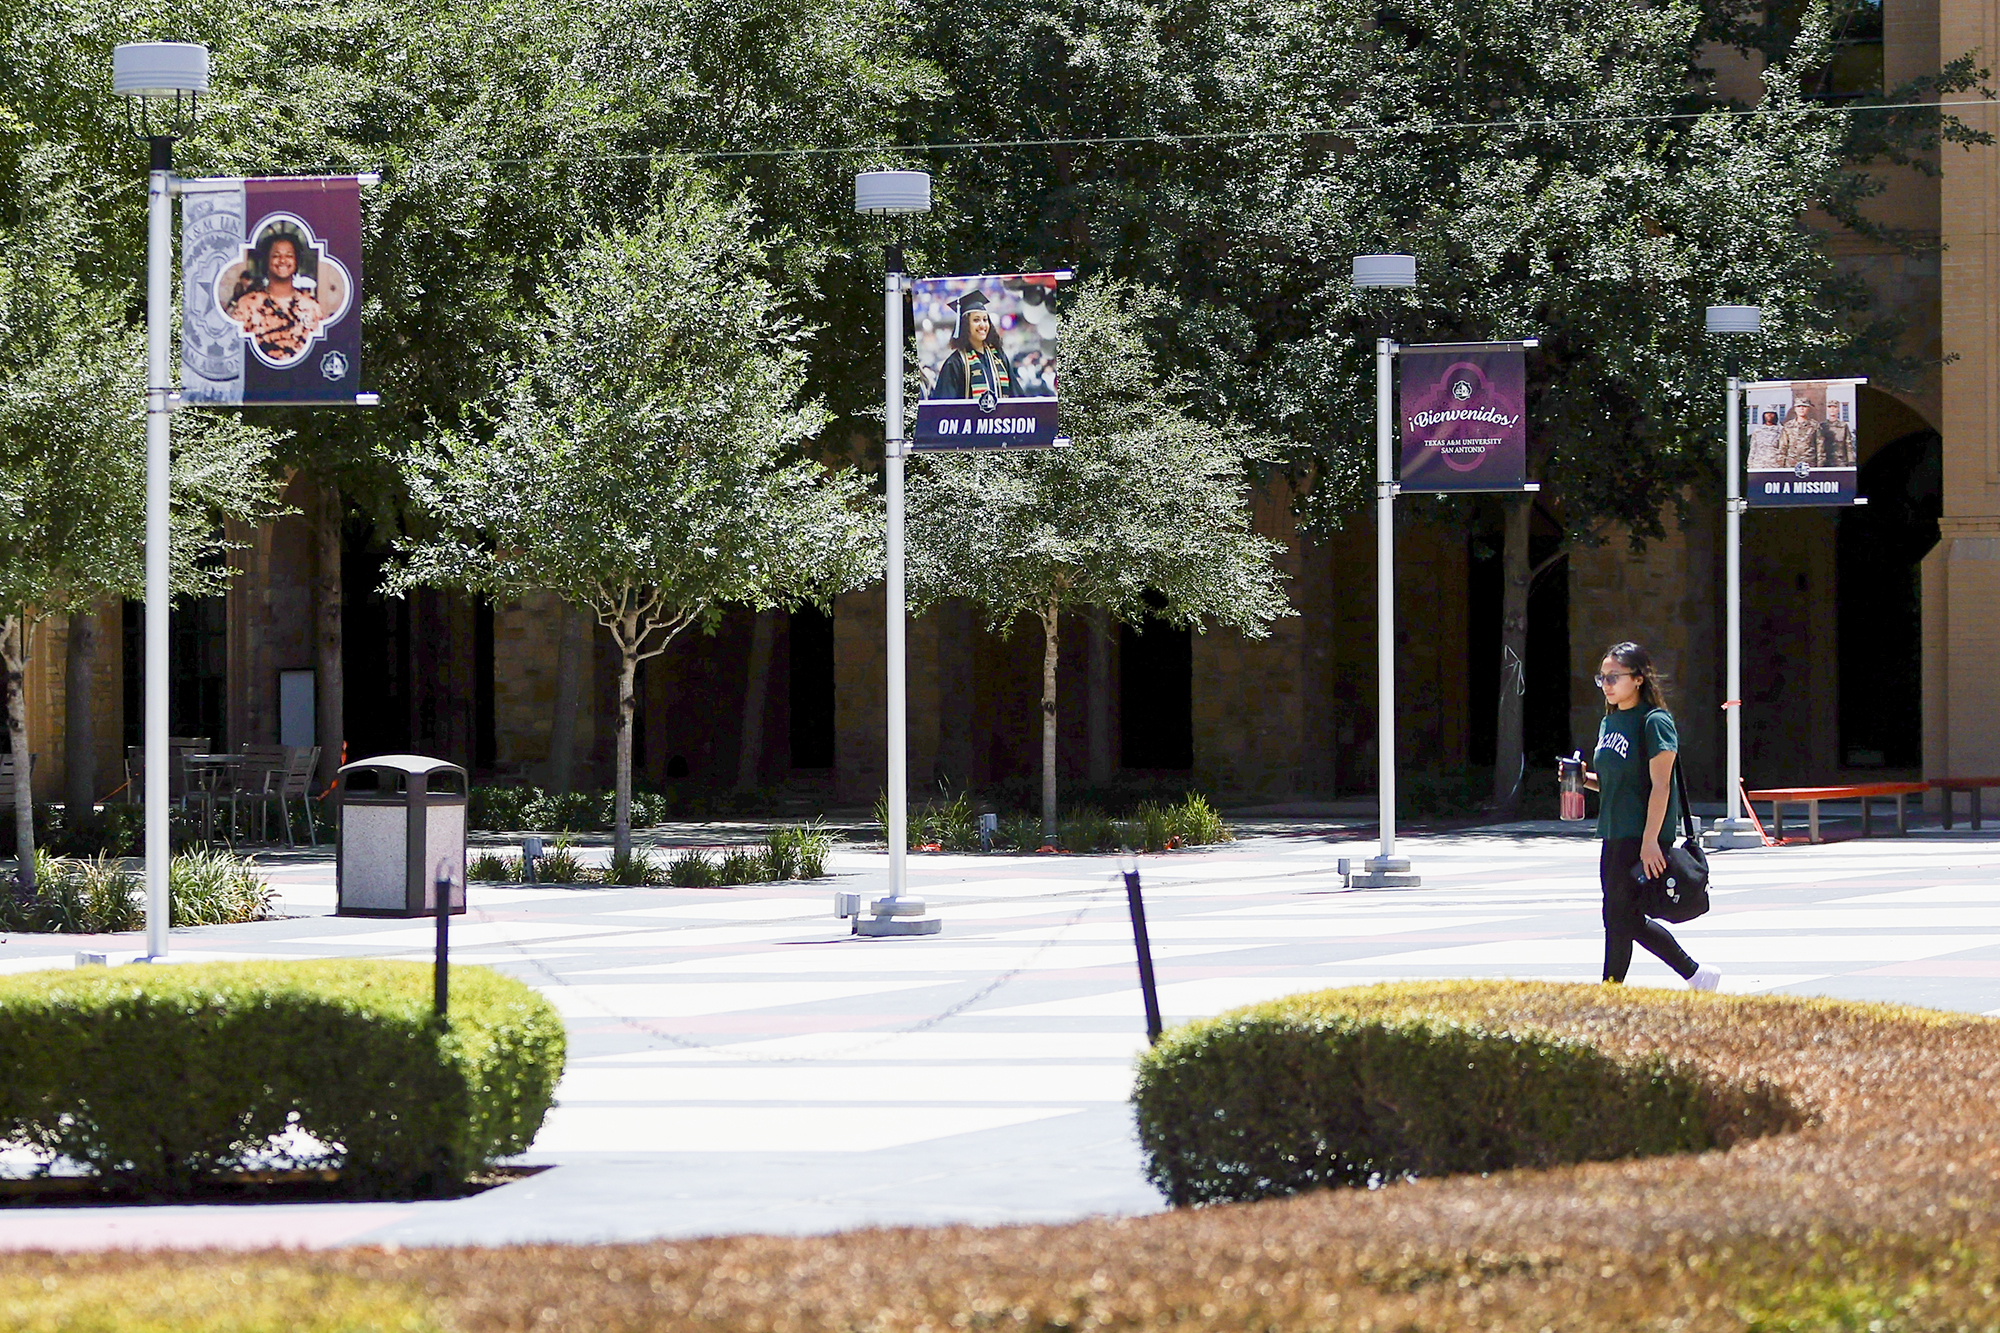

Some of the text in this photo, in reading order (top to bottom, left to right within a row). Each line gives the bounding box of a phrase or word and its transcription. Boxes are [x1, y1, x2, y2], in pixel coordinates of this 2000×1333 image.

[1408, 406, 1519, 432] ¡Bienvenidos!
[938, 417, 1036, 435] ON A MISSION
[1424, 439, 1446, 447] TEXAS
[1462, 438, 1502, 446] UNIVERSITY
[1441, 446, 1454, 454] SAN
[1764, 481, 1839, 494] ON A MISSION
